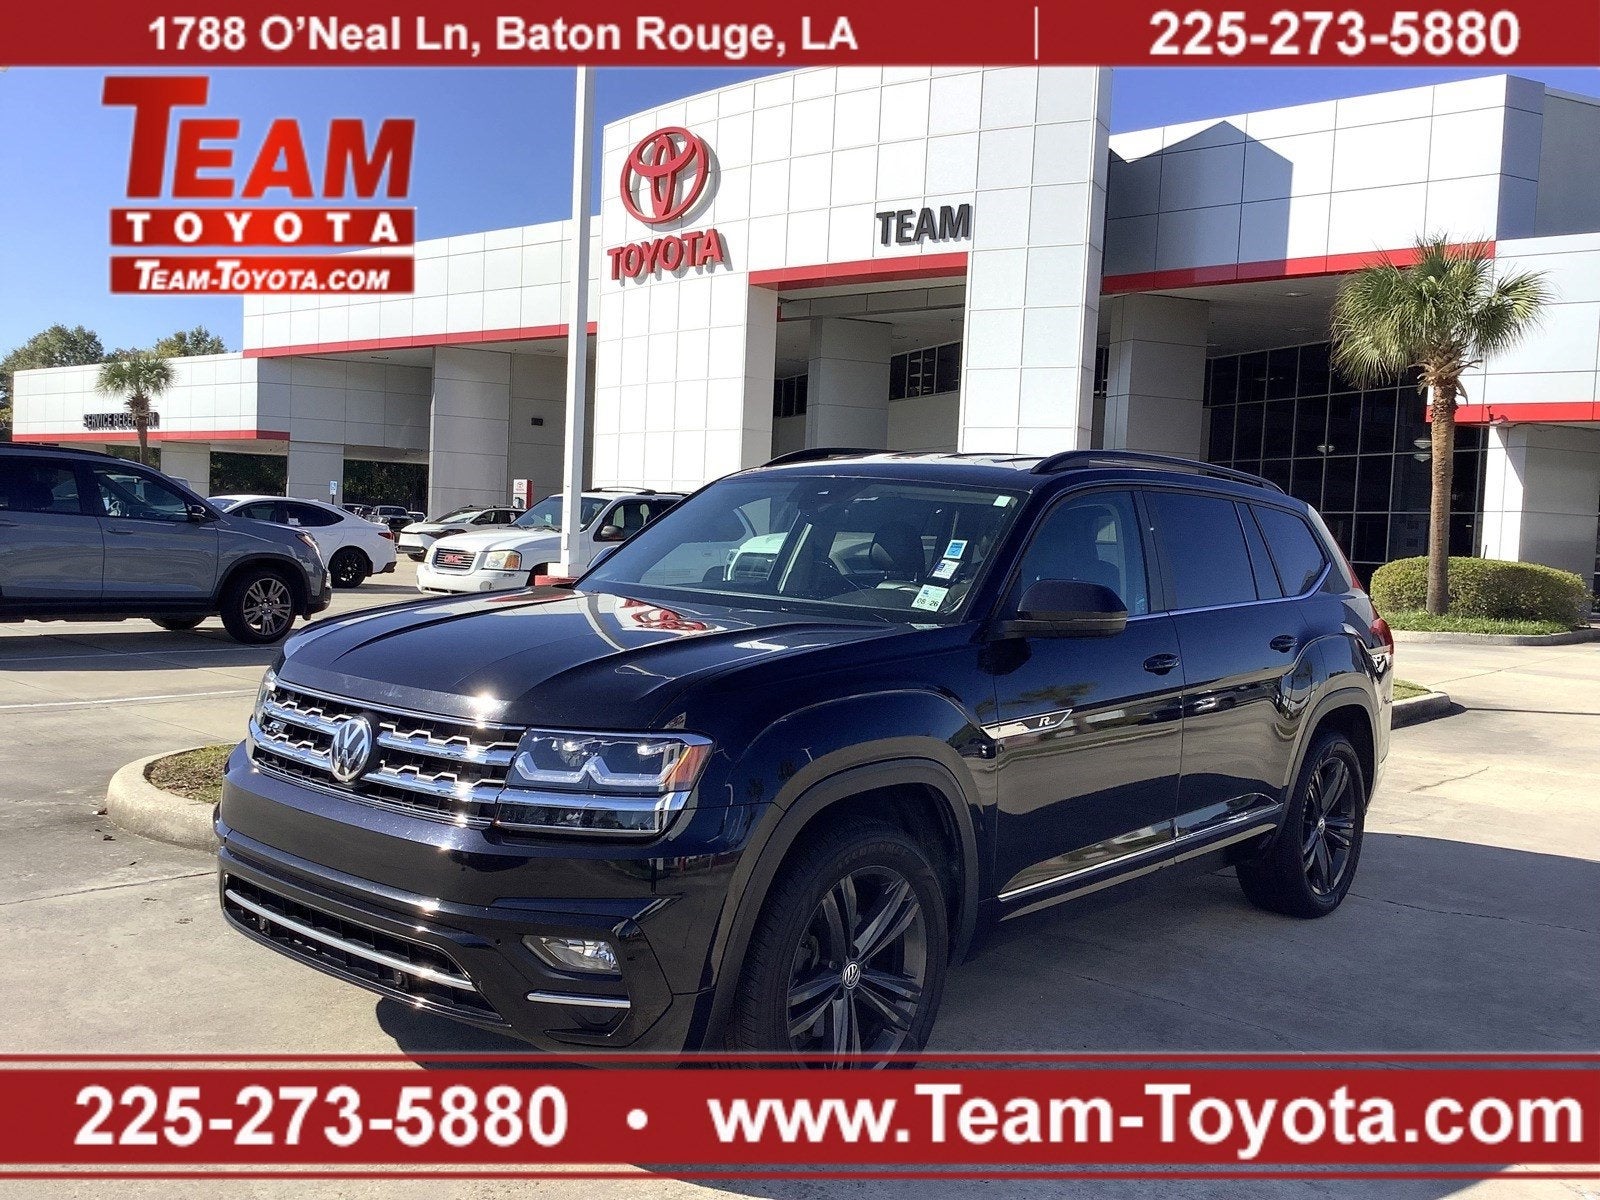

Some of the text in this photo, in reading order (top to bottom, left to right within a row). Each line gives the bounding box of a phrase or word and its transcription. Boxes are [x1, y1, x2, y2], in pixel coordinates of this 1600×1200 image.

[876, 203, 970, 244] TEAM
[607, 228, 724, 280] TOYOTA
[83, 412, 159, 429] SERVICE RECEN
